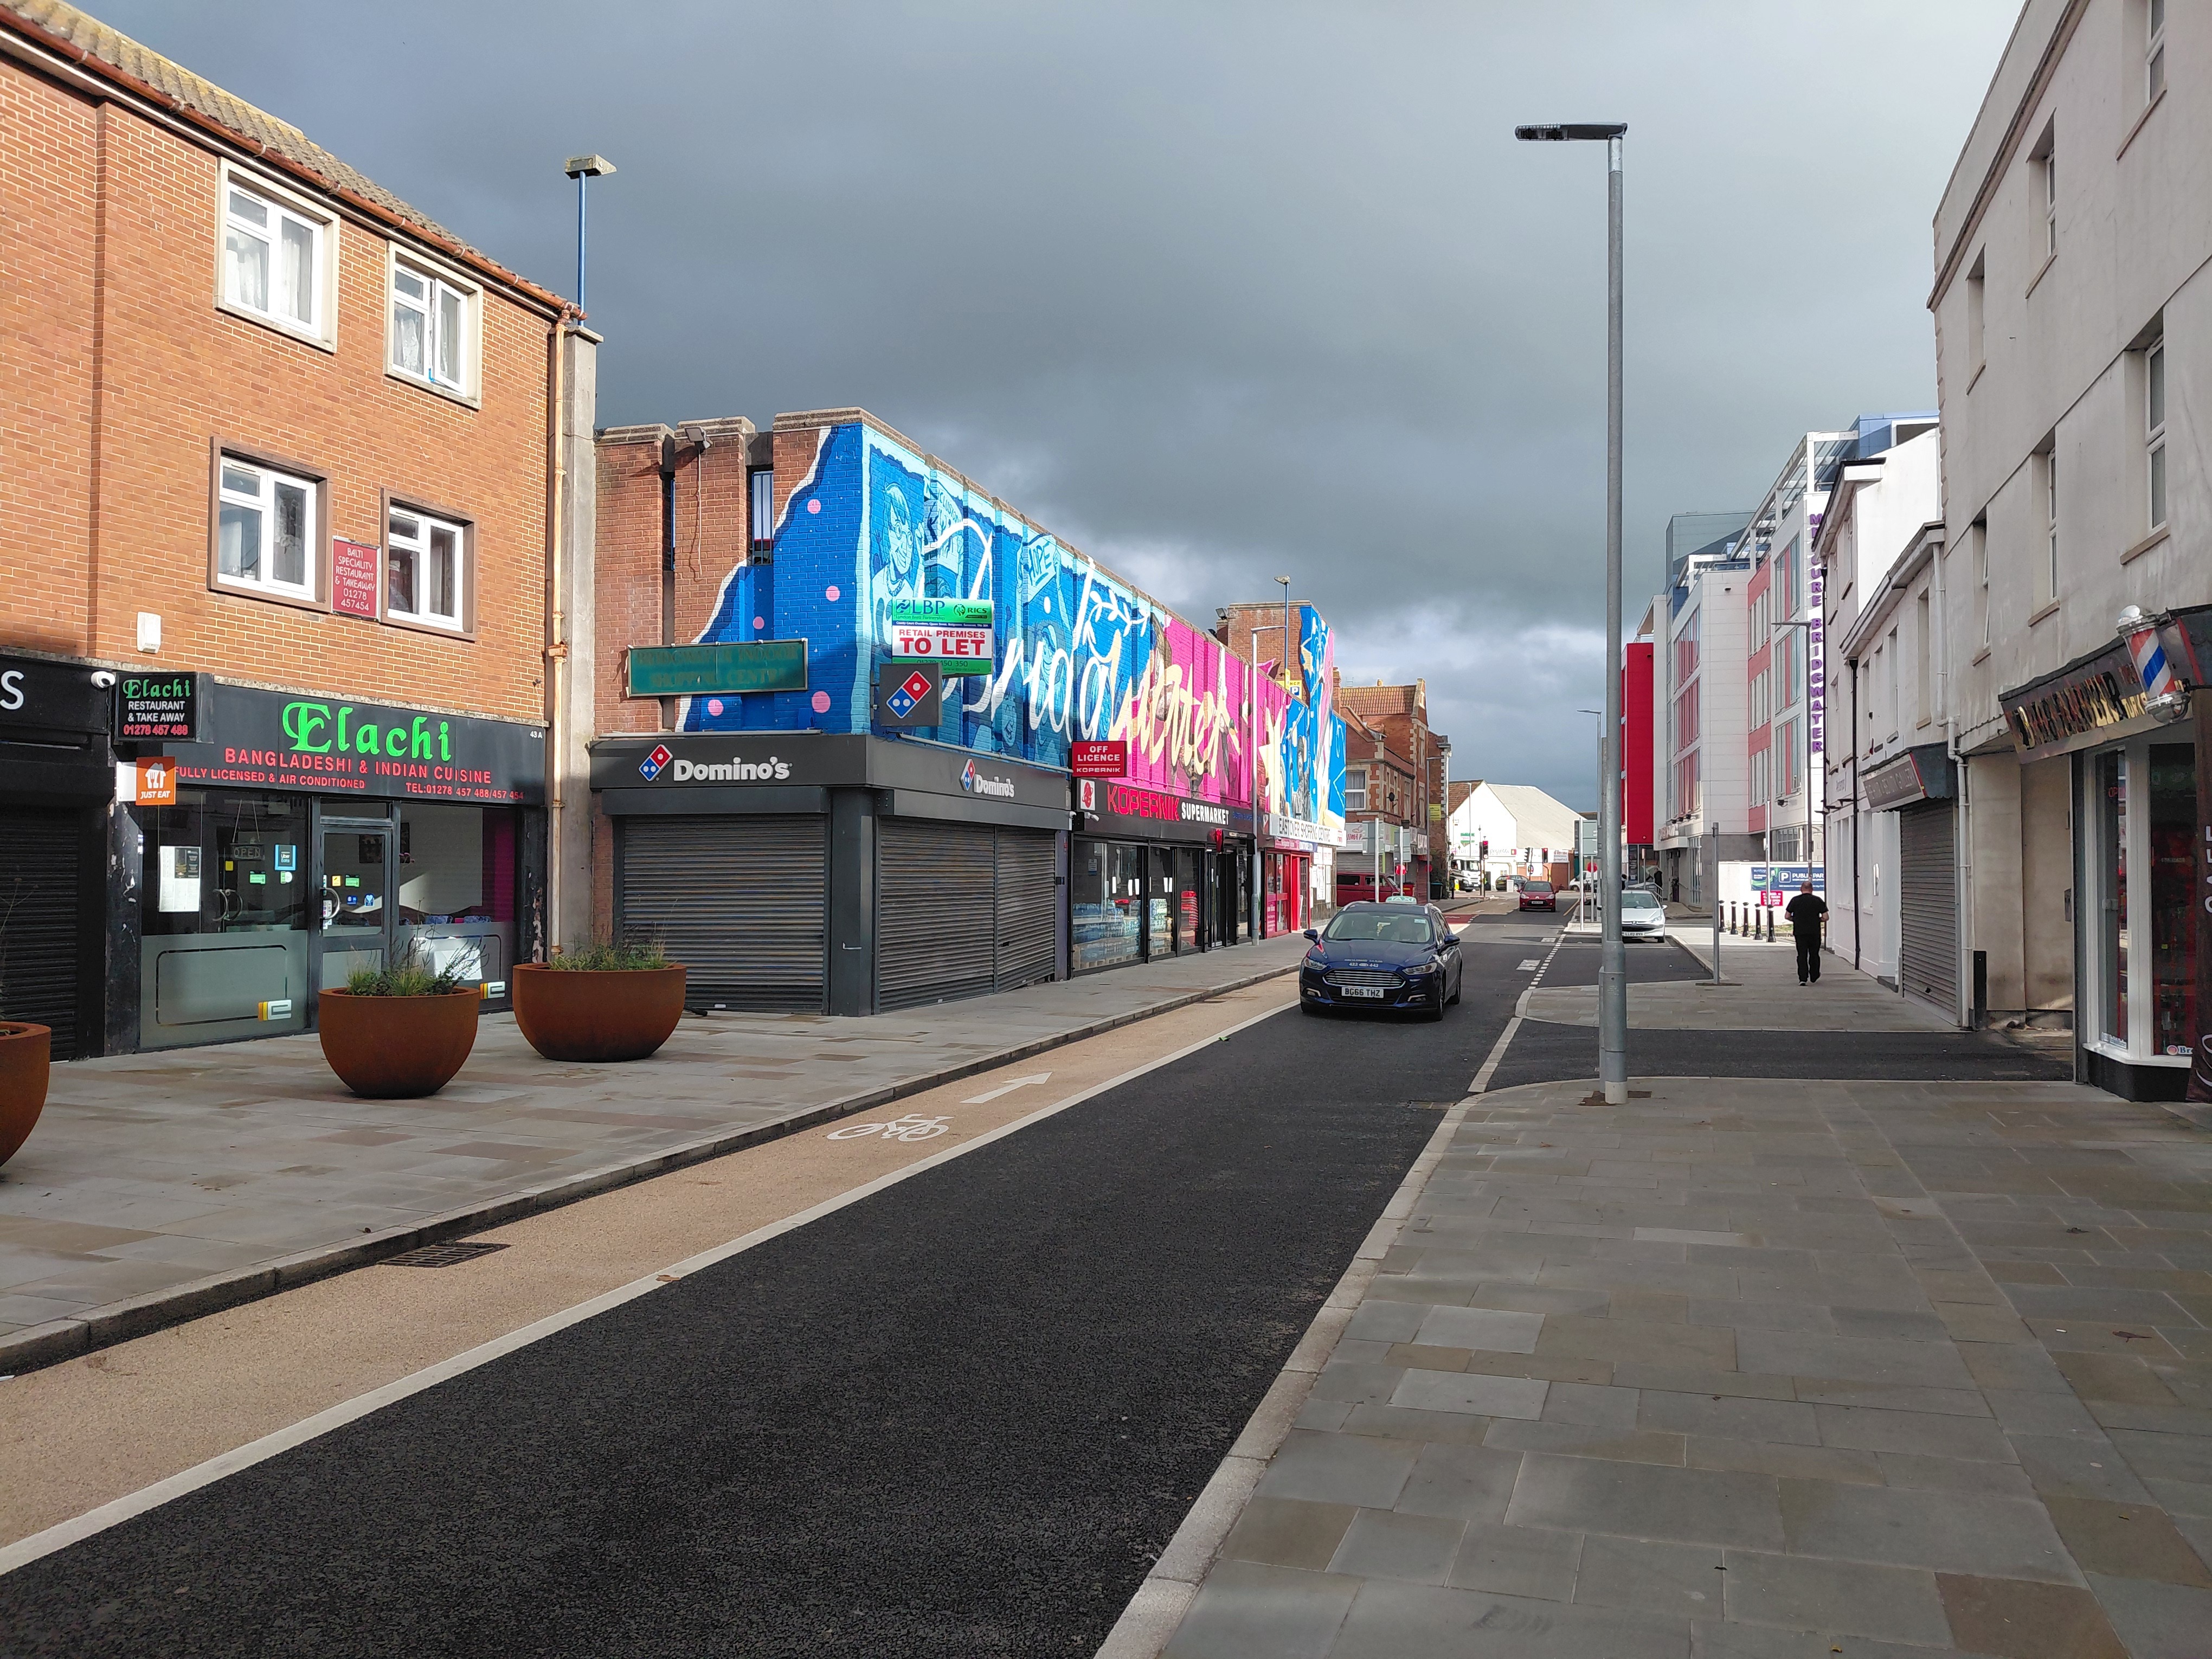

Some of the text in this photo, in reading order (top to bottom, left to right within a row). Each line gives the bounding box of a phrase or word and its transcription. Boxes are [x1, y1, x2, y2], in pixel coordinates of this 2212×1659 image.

[348, 548, 363, 559] BALTI
[338, 556, 373, 571] SPECIALITY
[336, 565, 374, 581] RESTAURANT
[335, 576, 375, 591] & TAKEAWAY
[343, 588, 367, 600] 01278
[340, 599, 369, 612] 457454
[912, 600, 945, 614] LBP
[899, 629, 986, 638] RETAIL PREMISES
[1810, 513, 1823, 753] MECURE BRIDGWATER
[900, 637, 985, 656] TO LET
[123, 679, 191, 698] Elachi
[128, 700, 185, 710] RESTAURANT
[127, 713, 185, 722] & TAKE AWAY
[124, 724, 188, 736] 01278 457 488
[282, 702, 451, 761] Elachi
[224, 747, 492, 784] BANGLADESHI & INDIAN CUISINE
[673, 756, 790, 781] Domino's
[210, 769, 265, 782] LICENSED
[268, 773, 276, 783] &
[279, 774, 297, 785] AIR
[299, 775, 366, 789] CONDITIONED
[974, 774, 1014, 798] Domino's
[140, 790, 171, 800] JUST EAT
[406, 782, 453, 795] TEL:01278
[456, 787, 471, 797] 457
[1107, 784, 1230, 825] KOPERNIK SUPERMARKET
[1279, 818, 1300, 838] EASTOVER
[1301, 822, 1317, 840] SHOPPING
[1319, 826, 1330, 843] CENTRE
[234, 848, 260, 858] OPEN
[1781, 872, 1789, 881] P
[1366, 989, 1380, 997] THZ
